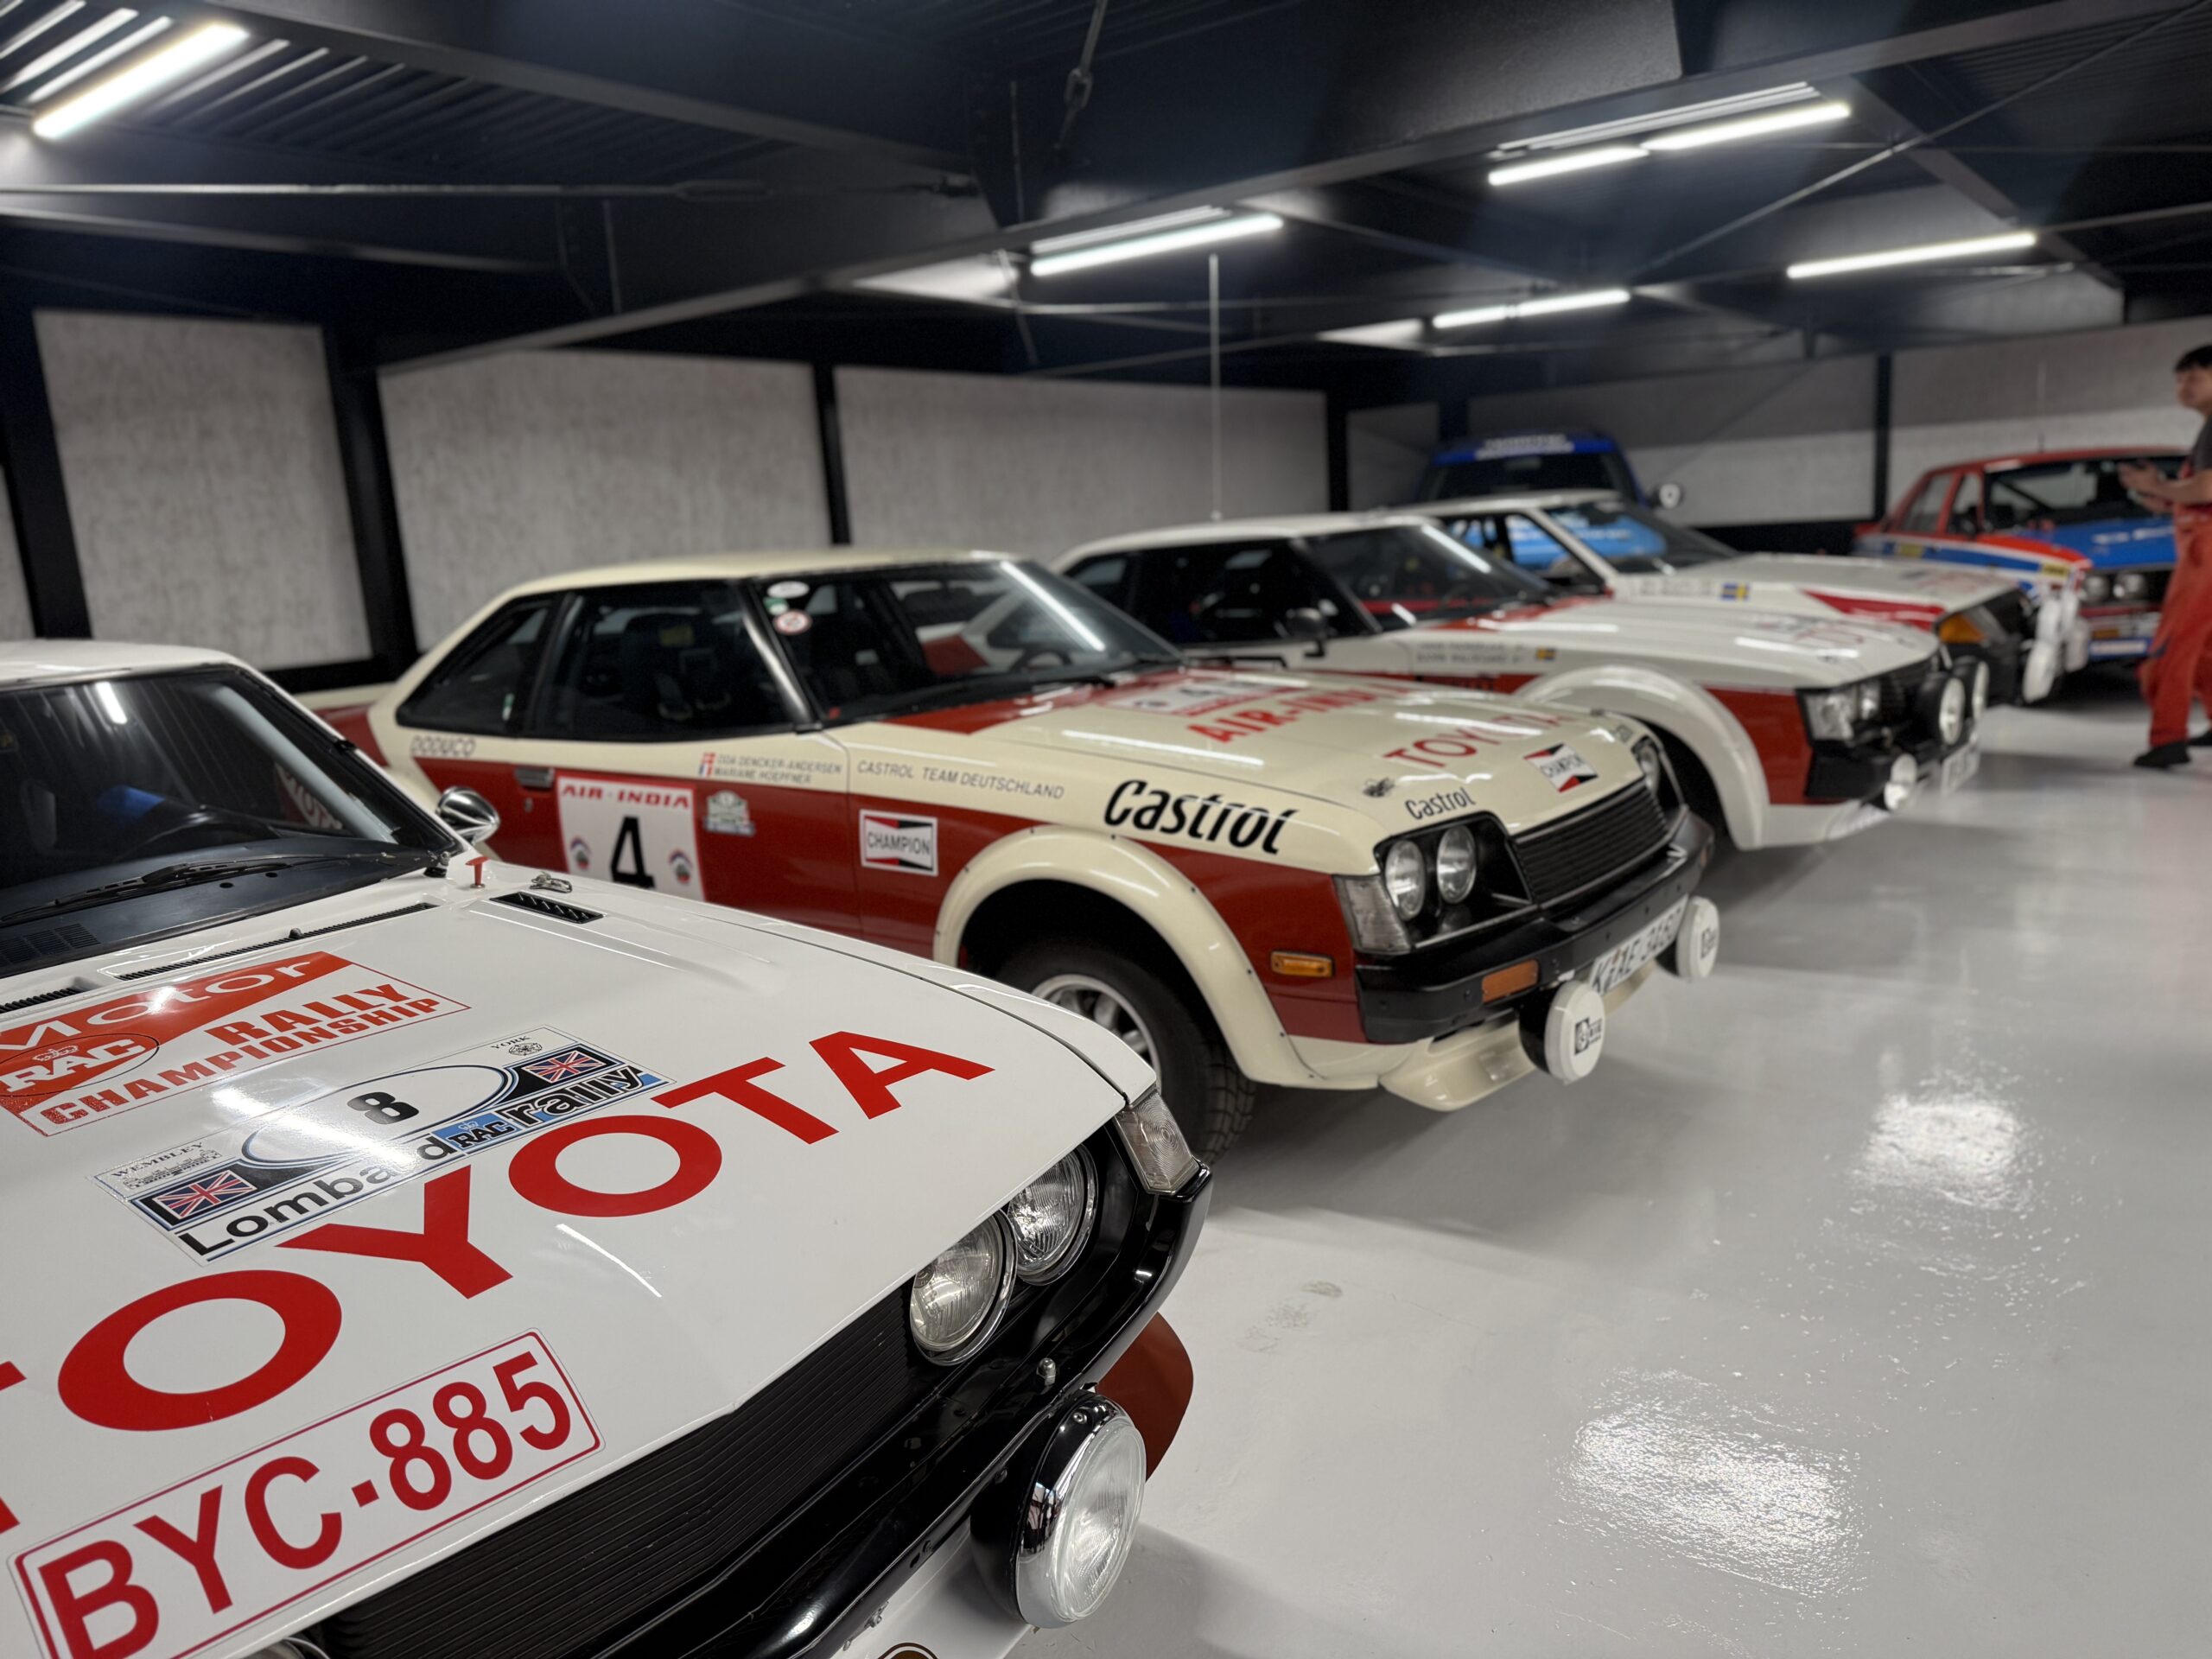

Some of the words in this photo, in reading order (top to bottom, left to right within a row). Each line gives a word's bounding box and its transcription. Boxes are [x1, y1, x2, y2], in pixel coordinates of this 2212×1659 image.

[857, 760, 915, 779] CASTROL
[922, 766, 959, 785] TEAM
[960, 772, 1065, 800] DEUTSCHLAND
[1404, 787, 1476, 821] Castrol
[867, 830, 931, 856] CHAMPION
[1103, 779, 1300, 855] Castrol
[608, 816, 657, 890] 4
[205, 982, 412, 1046] RALLY
[1, 1039, 146, 1093] RAC
[40, 996, 442, 1125] CHAMPIONSHIP
[490, 1034, 531, 1052] YORK
[346, 1091, 420, 1126] 8
[111, 1141, 204, 1178] WEMBLEY
[177, 1134, 458, 1256] Lombad
[504, 1065, 645, 1128] rally
[0, 1030, 995, 1535] OYOTA
